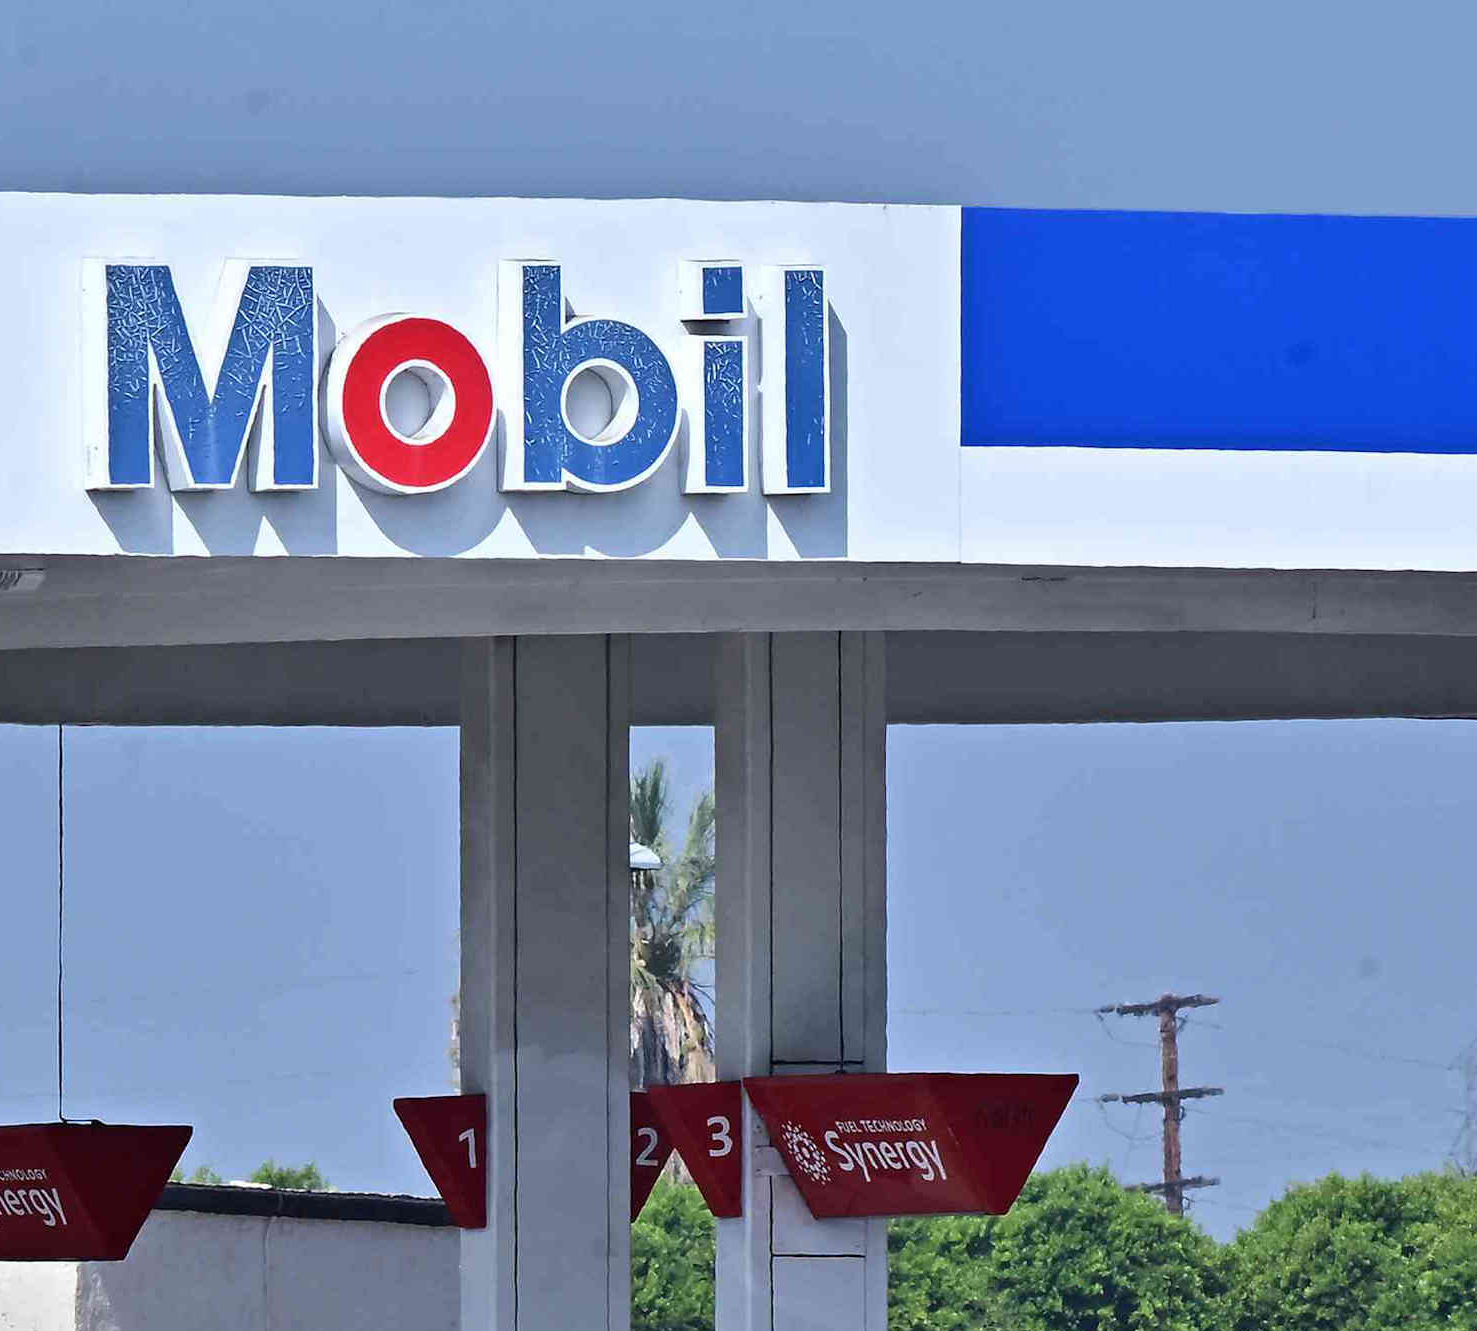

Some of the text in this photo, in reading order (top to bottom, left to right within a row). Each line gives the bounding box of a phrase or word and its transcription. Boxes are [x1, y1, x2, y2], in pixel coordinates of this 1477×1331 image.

[96, 259, 829, 492] Mobil
[706, 1116, 734, 1158] 3
[835, 1118, 927, 1134] FUEL TECHNOLOGY
[458, 1128, 477, 1169] 1
[635, 1127, 659, 1167] 2
[825, 1130, 947, 1183] Synergy
